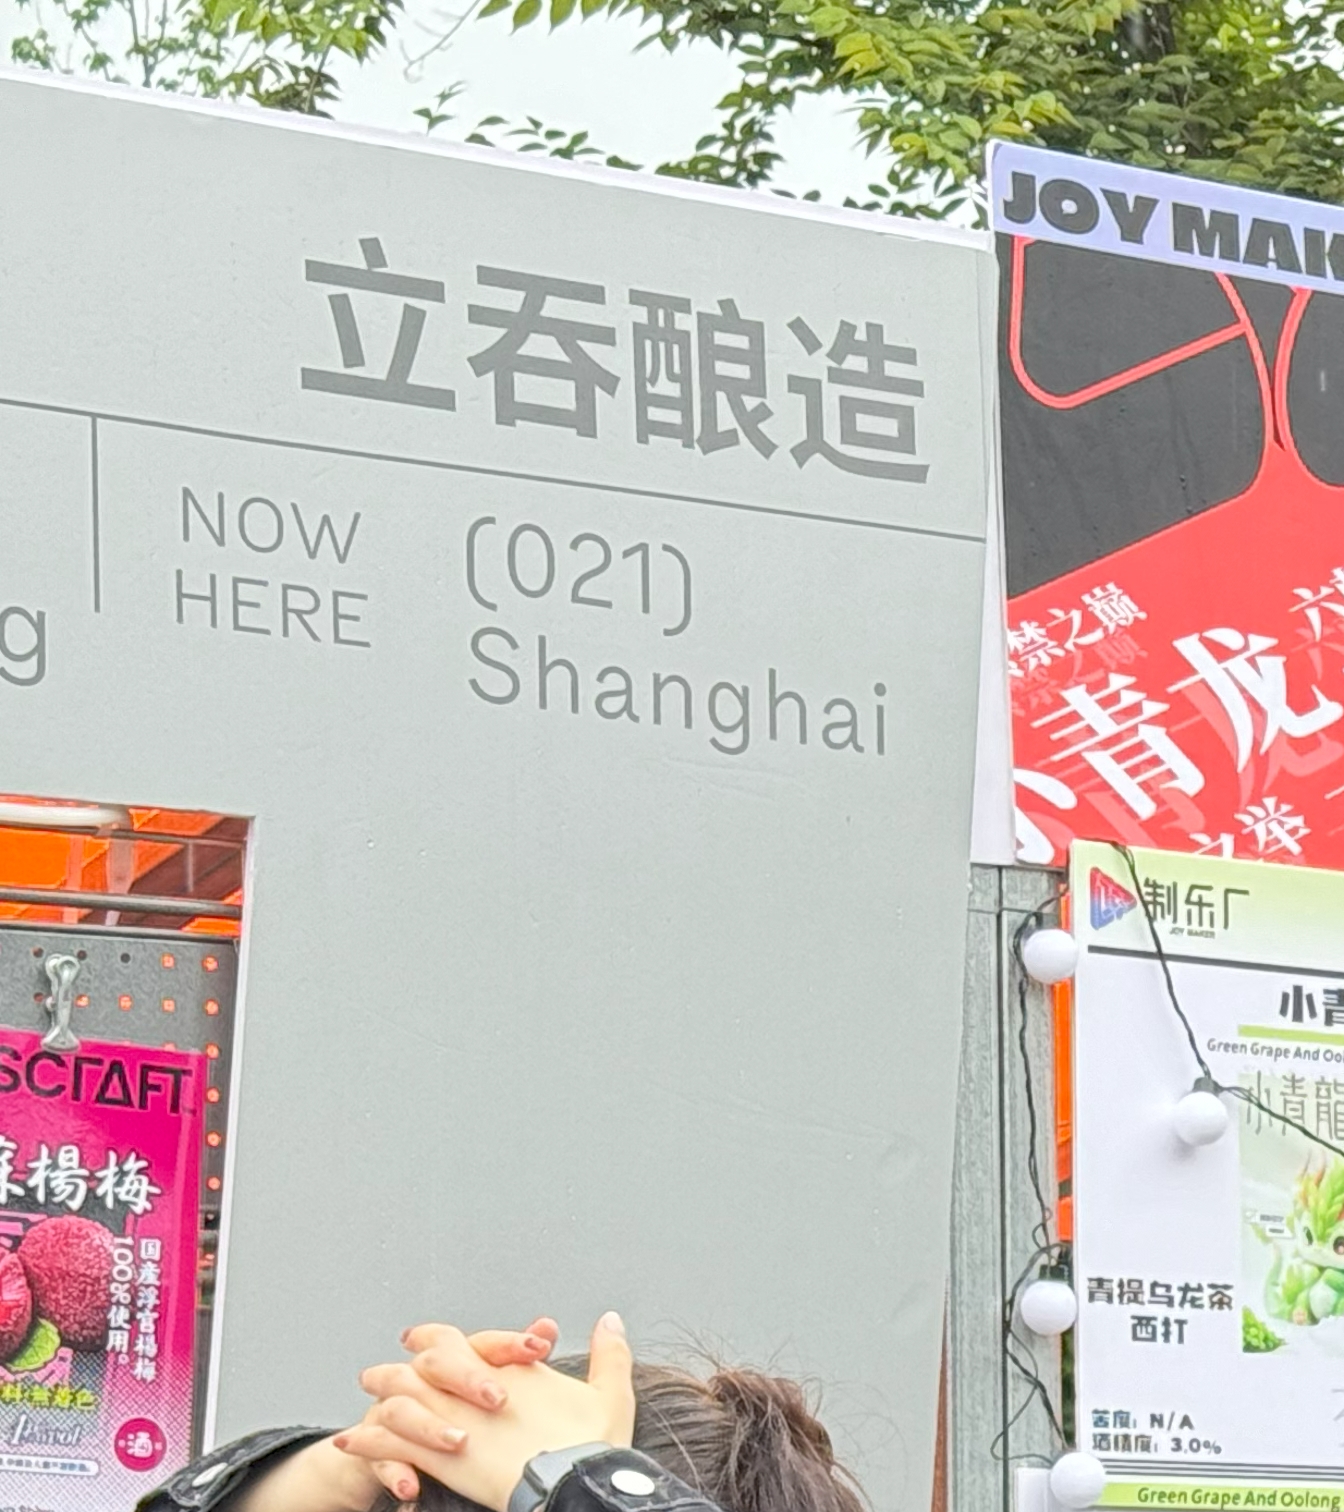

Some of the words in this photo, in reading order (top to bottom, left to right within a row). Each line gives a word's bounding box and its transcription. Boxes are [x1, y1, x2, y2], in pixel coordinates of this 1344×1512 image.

[1002, 172, 1157, 244] JOY
[301, 236, 930, 485] 立吞酿造
[180, 486, 361, 564] NOW
[466, 516, 694, 636] (021)
[176, 568, 371, 648] HERE
[1007, 581, 1148, 677] 禁之巅
[467, 625, 888, 756] Shanghai
[1144, 877, 1249, 930] 制乐厂
[1207, 1038, 1247, 1054] Green
[1251, 1041, 1290, 1062] Grape
[1294, 1045, 1320, 1061] And
[1087, 1277, 1234, 1311] 青提乌龙茶
[1131, 1315, 1188, 1344] 西打
[1150, 1412, 1194, 1431] N/A
[1170, 1438, 1222, 1455] 3.0%
[1137, 1487, 1186, 1504] Green
[1191, 1489, 1241, 1510] Grape
[1245, 1490, 1277, 1507] And
[1280, 1492, 1341, 1512] Oolong
